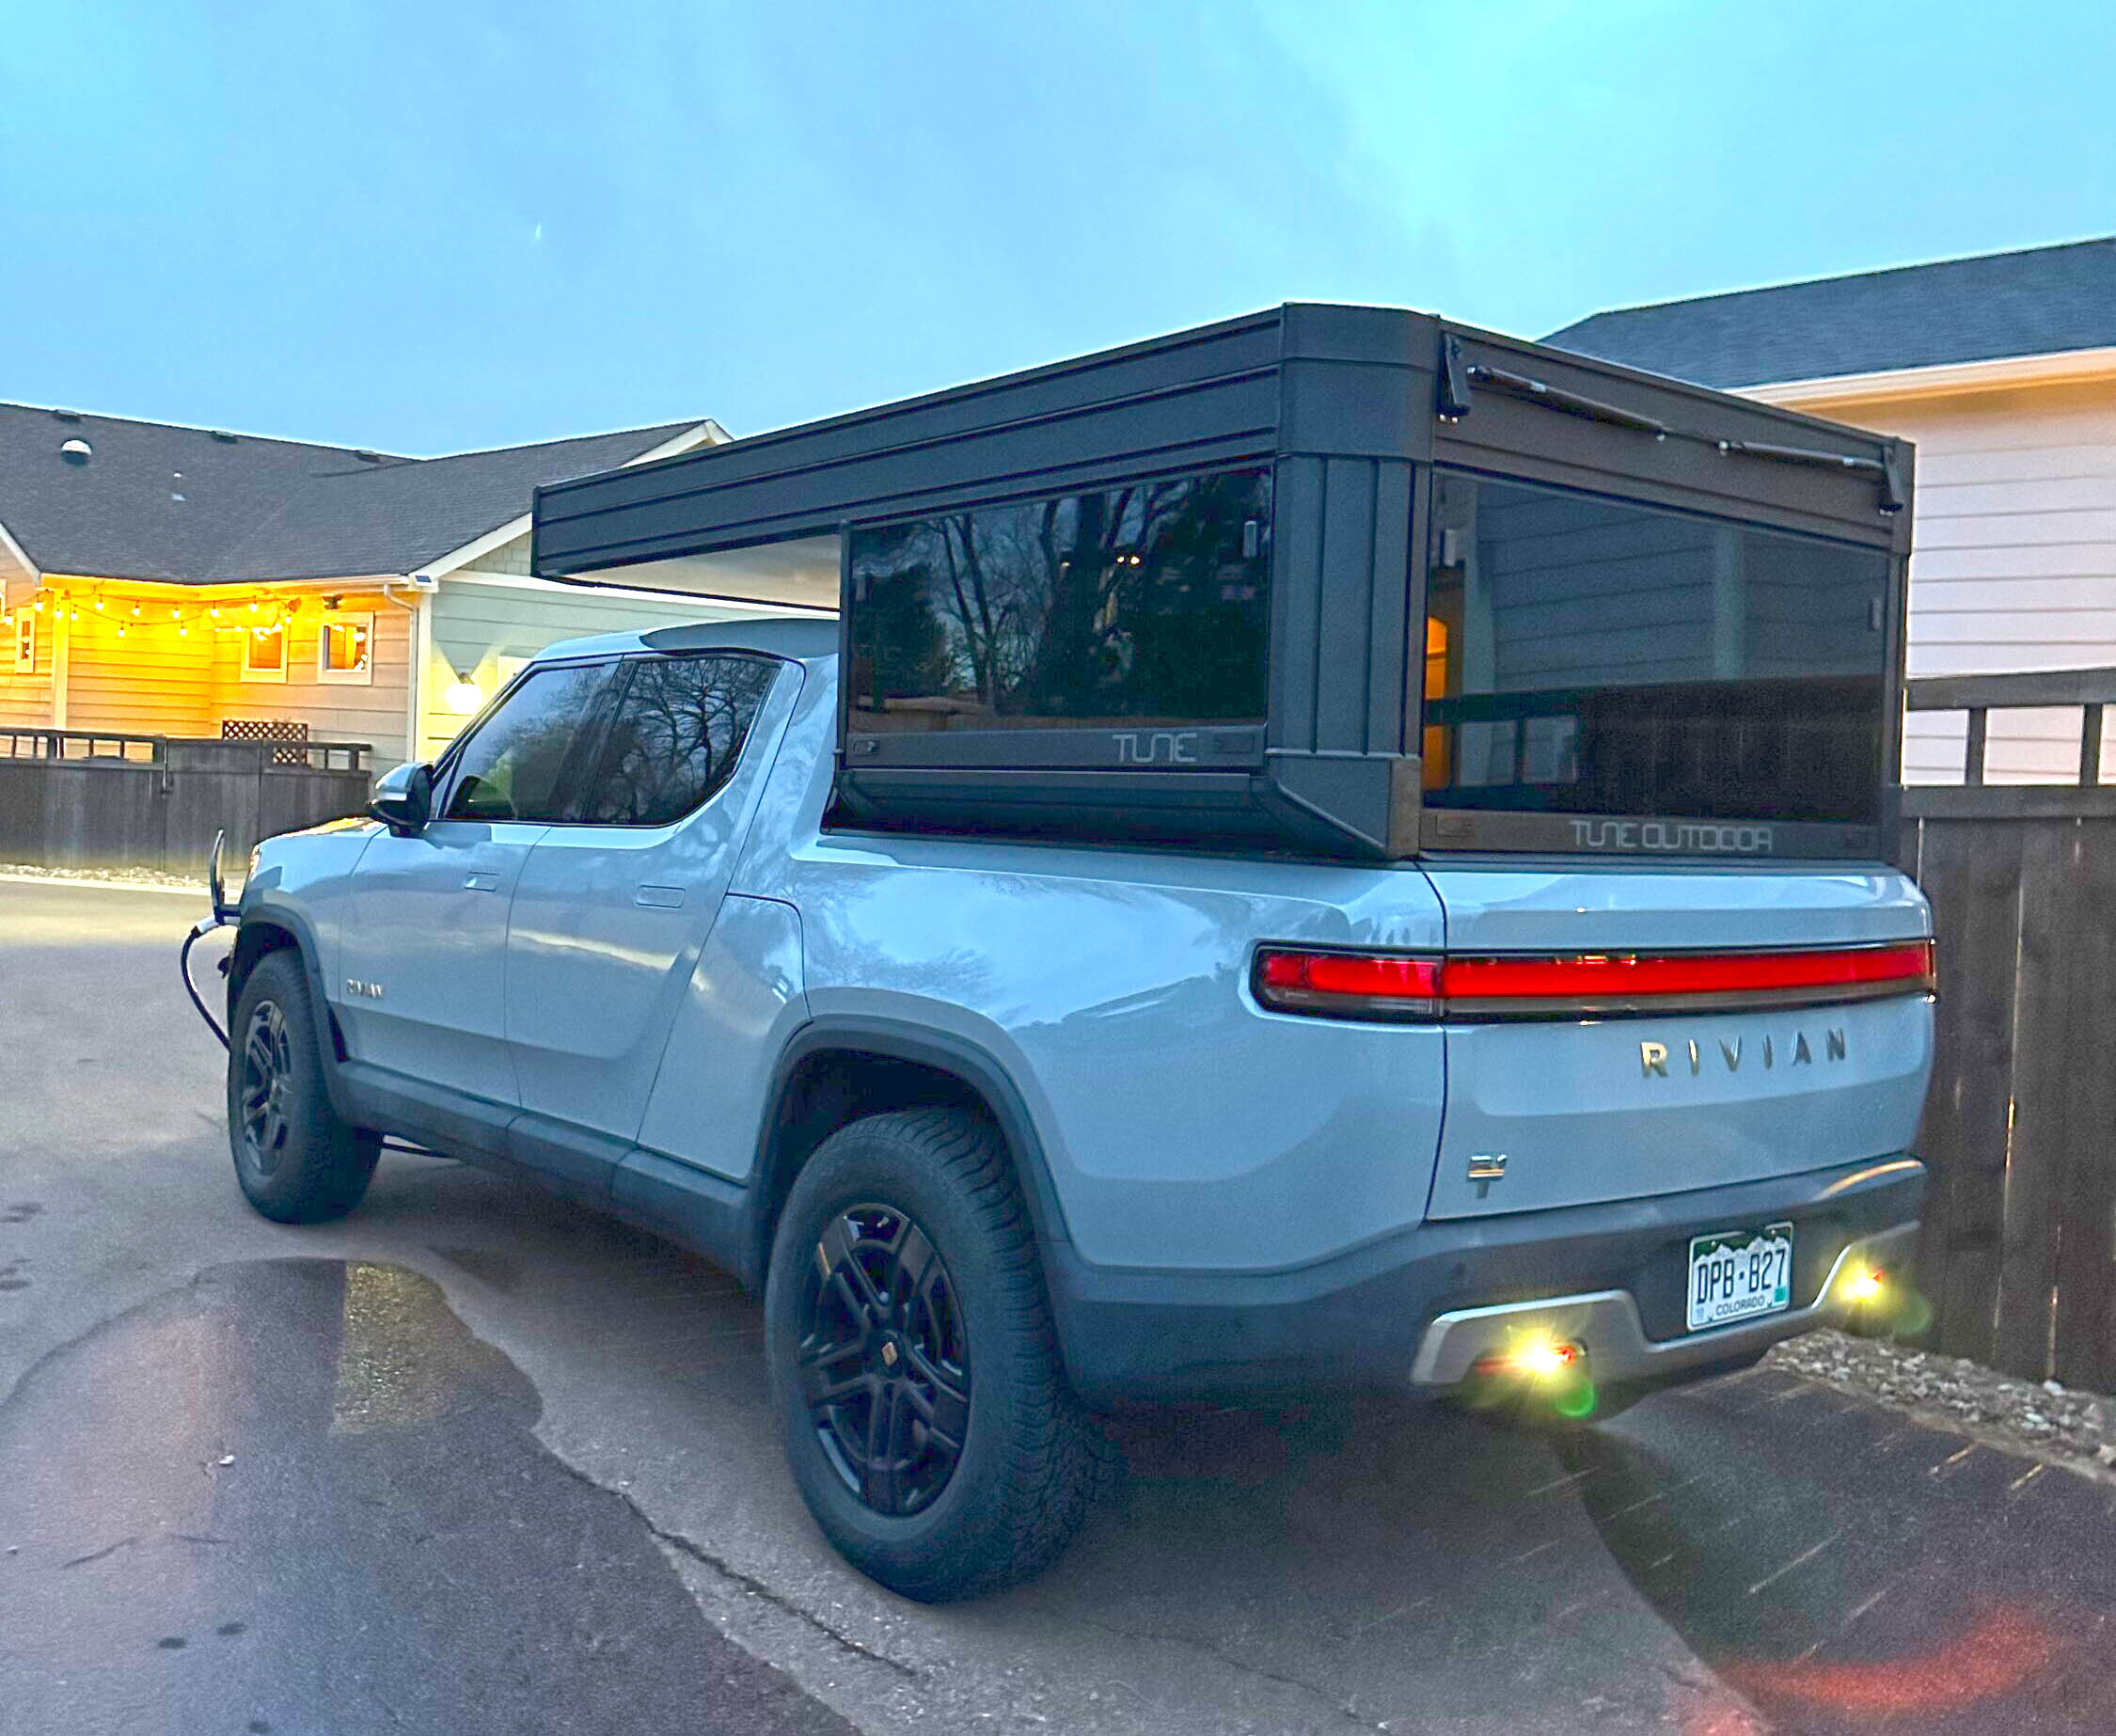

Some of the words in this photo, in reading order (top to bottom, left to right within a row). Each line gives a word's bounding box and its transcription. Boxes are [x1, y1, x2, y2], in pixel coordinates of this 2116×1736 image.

[1113, 733, 1197, 763] TUNE
[1570, 820, 1637, 848] TUNE
[1642, 823, 1773, 852] OUTDOOR
[1640, 1028, 1846, 1078] RIVIAN
[1715, 1295, 1765, 1317] COLORADO
